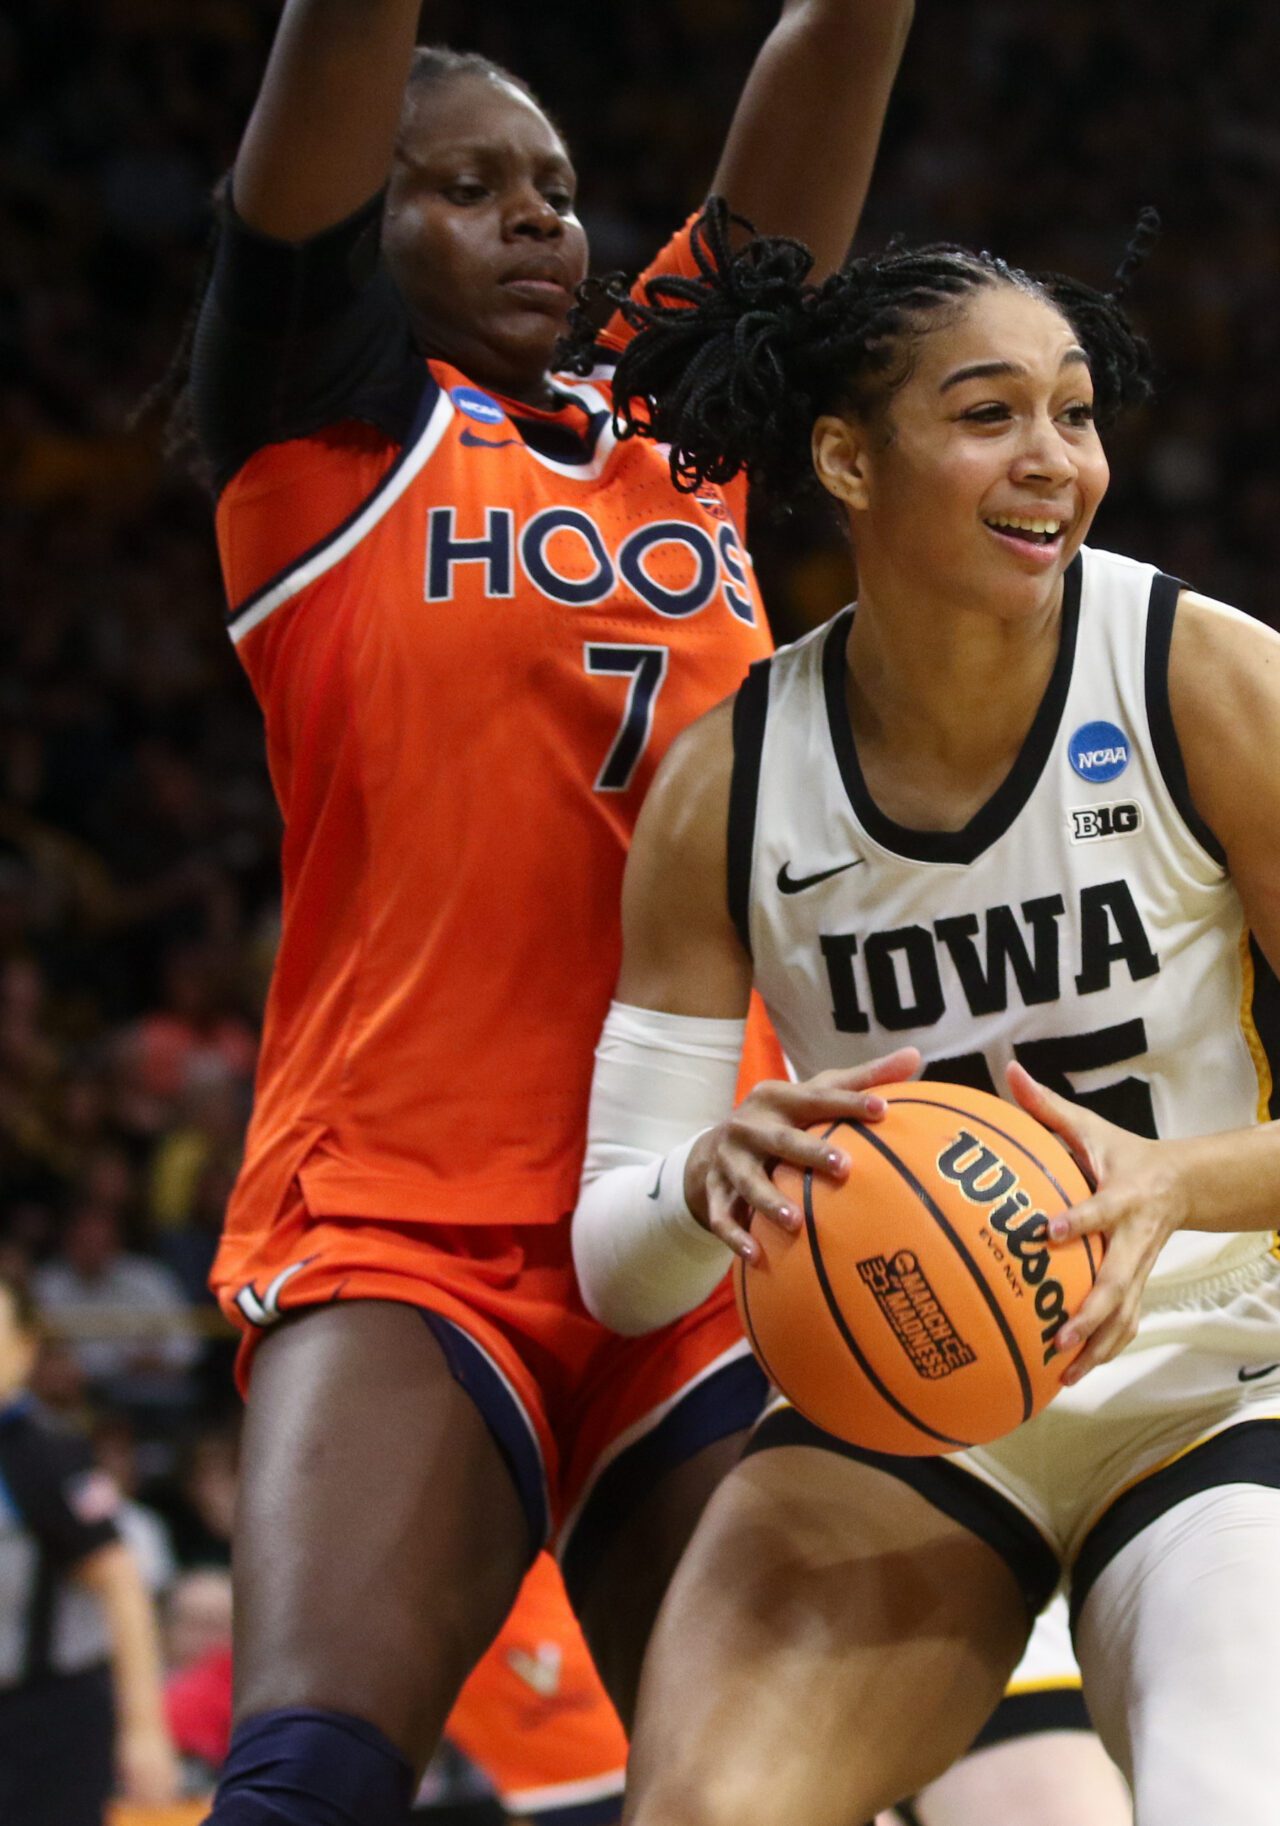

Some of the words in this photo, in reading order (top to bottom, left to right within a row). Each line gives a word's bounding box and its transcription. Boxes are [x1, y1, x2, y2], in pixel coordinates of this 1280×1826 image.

[425, 506, 757, 630] HOOS
[583, 641, 669, 793] 7
[1078, 746, 1127, 769] NCAA
[820, 878, 1160, 1034] IOWA
[883, 1290, 953, 1378] MADNESS
[899, 1270, 953, 1342] MARCH
